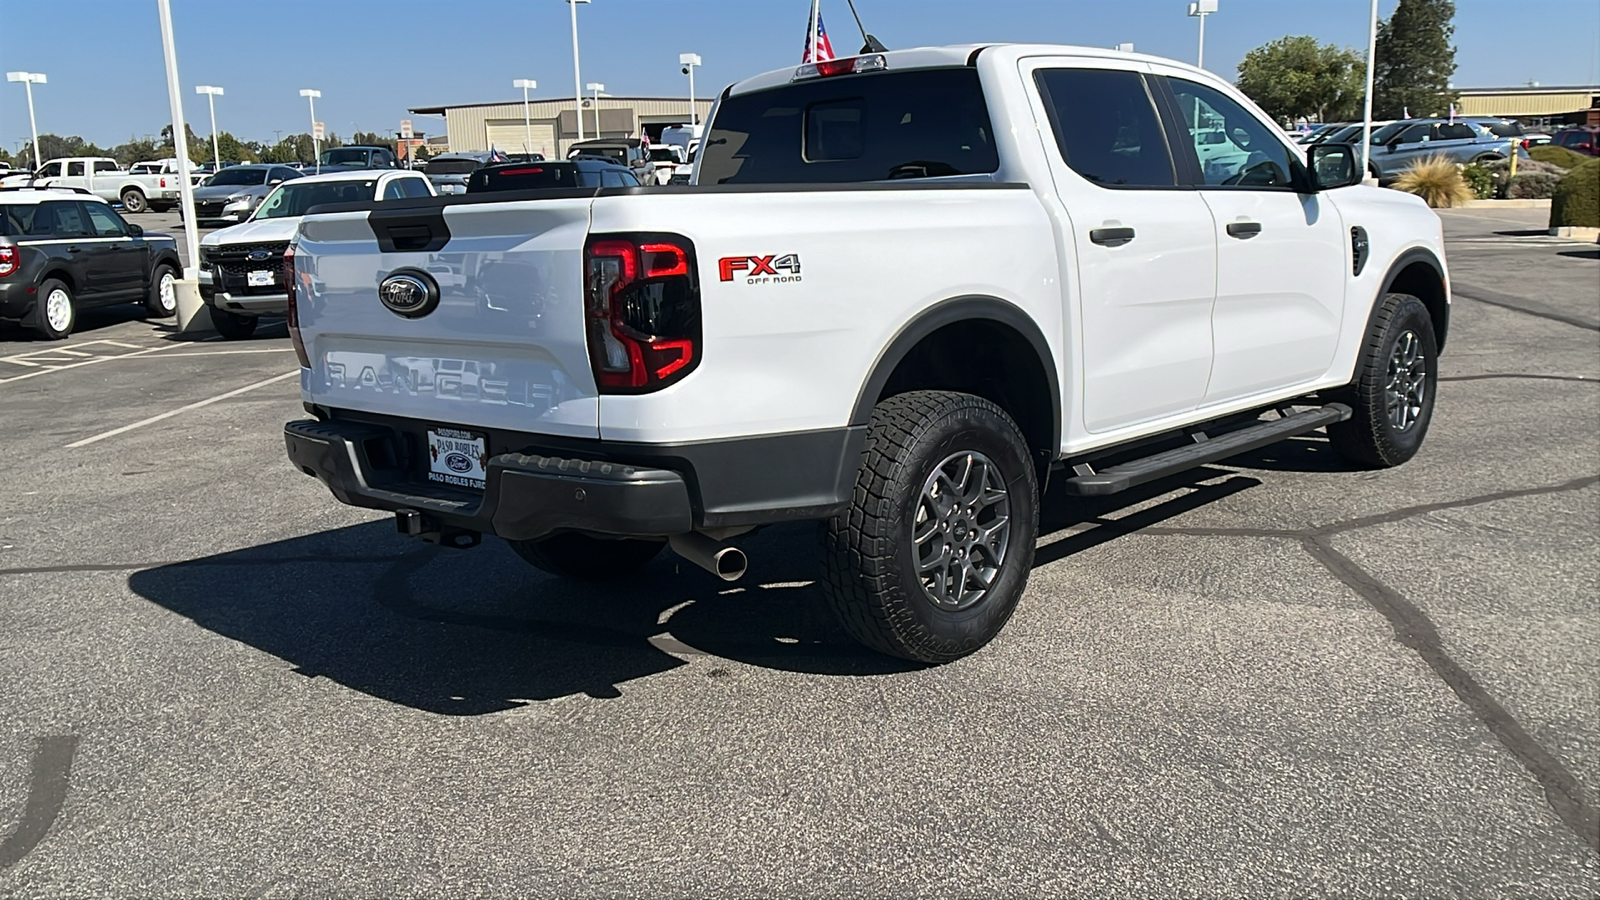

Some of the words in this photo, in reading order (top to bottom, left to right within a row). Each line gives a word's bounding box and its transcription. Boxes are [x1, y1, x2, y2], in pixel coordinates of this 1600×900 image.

[718, 253, 801, 282] FX4
[773, 275, 802, 284] ROAD
[381, 282, 415, 304] Ford
[326, 361, 559, 412] RANGER
[437, 439, 454, 455] PASO
[455, 441, 480, 460] ROBLES
[449, 456, 469, 470] Ford
[428, 472, 444, 482] PASO
[445, 475, 469, 487] ROBLES
